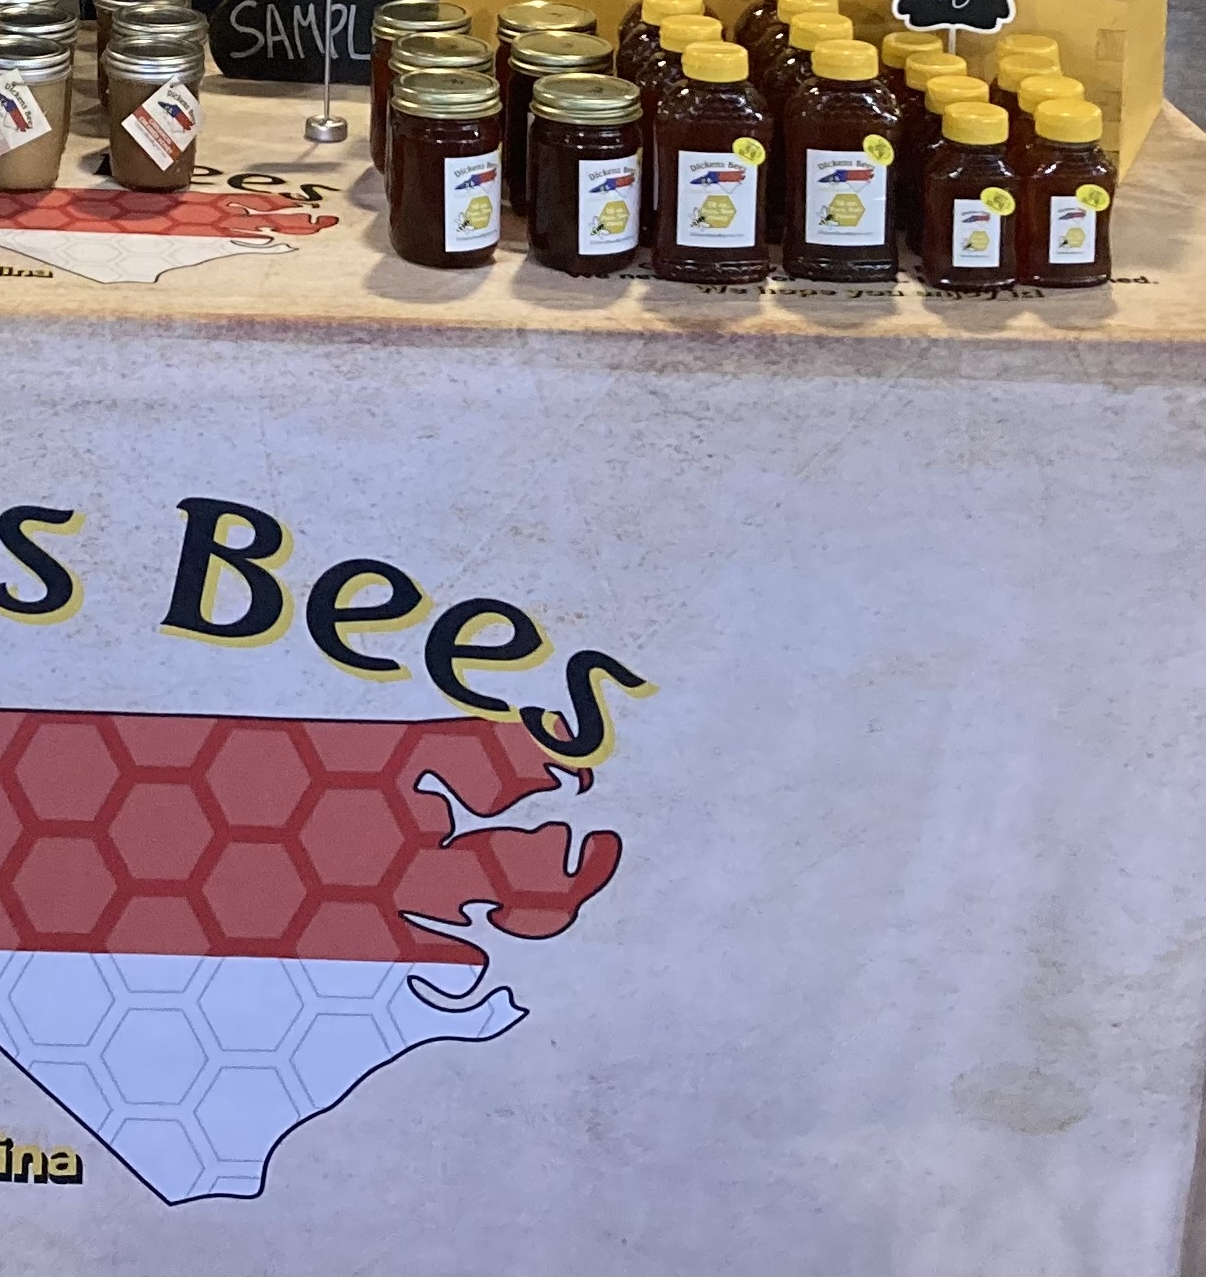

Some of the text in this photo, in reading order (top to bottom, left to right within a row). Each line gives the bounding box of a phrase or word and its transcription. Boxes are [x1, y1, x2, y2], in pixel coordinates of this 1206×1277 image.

[229, 0, 371, 61] SAMPL
[696, 284, 748, 295] We
[757, 285, 836, 298] hope
[845, 287, 905, 300] you
[159, 496, 659, 770] Bees
